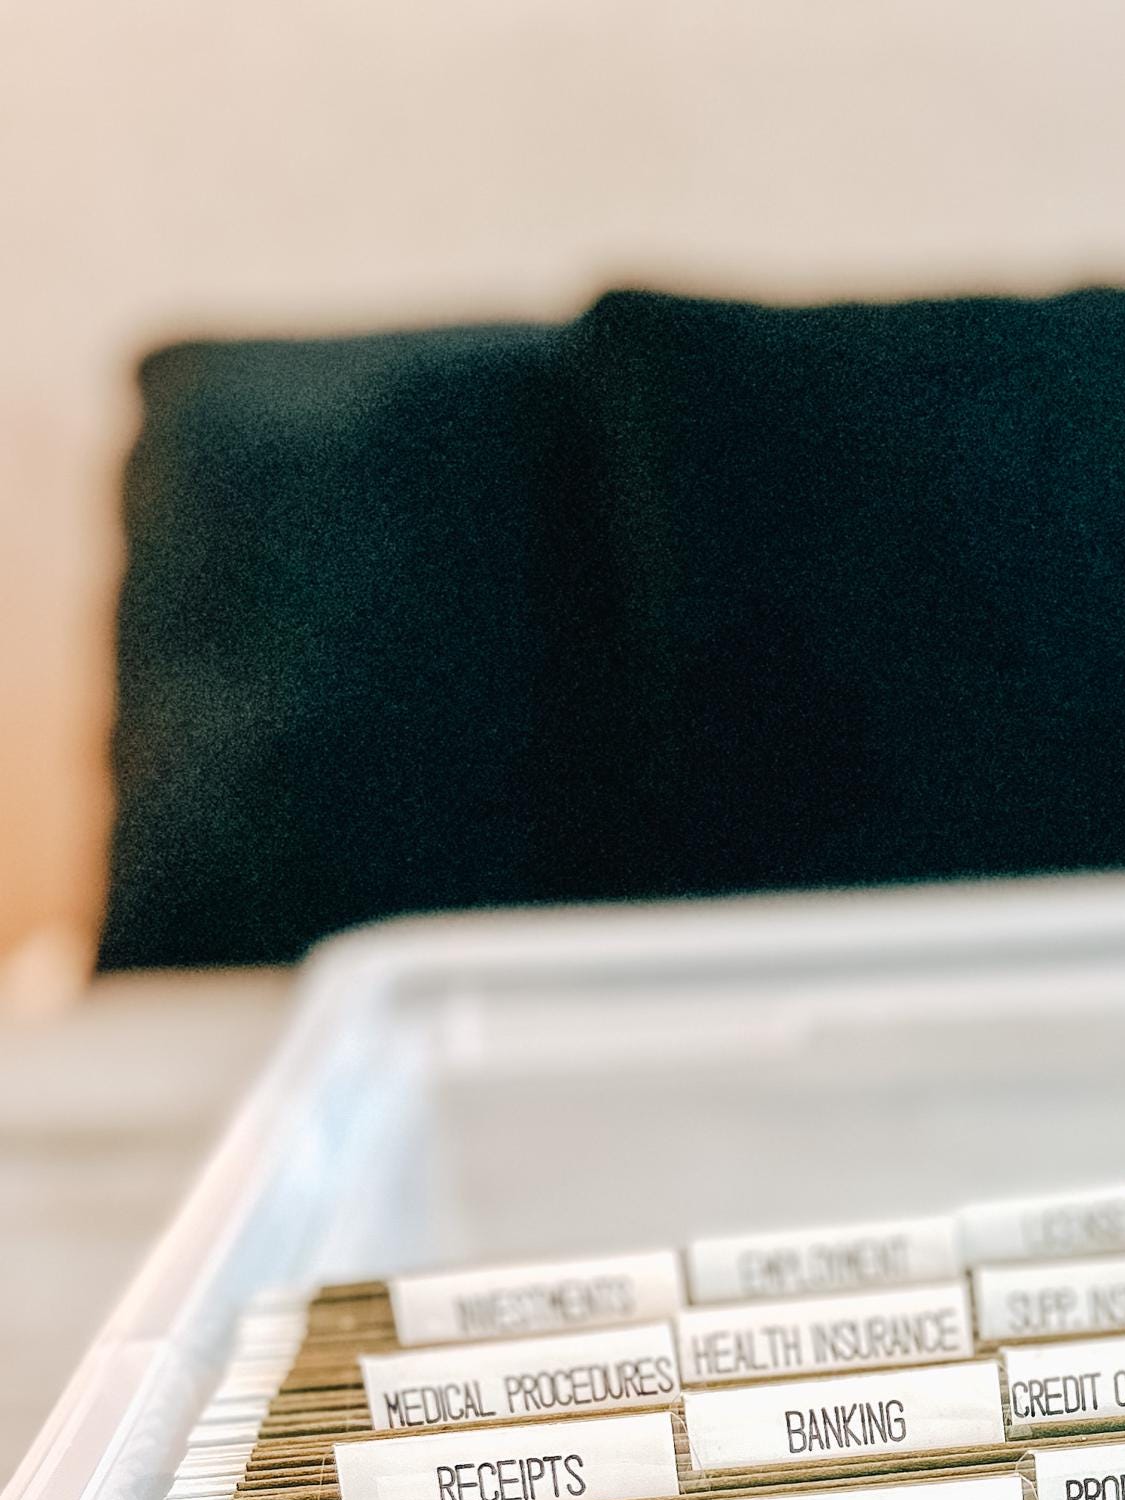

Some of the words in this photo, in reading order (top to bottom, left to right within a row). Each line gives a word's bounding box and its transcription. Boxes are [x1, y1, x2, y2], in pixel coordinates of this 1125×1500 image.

[692, 1327, 800, 1375] HEALTH
[814, 1308, 962, 1364] INSURANCE
[384, 1380, 496, 1429] MEDICAL
[507, 1355, 675, 1414] PROCEDURES
[1012, 1371, 1101, 1419] CREDIT
[785, 1400, 906, 1454] BANKING
